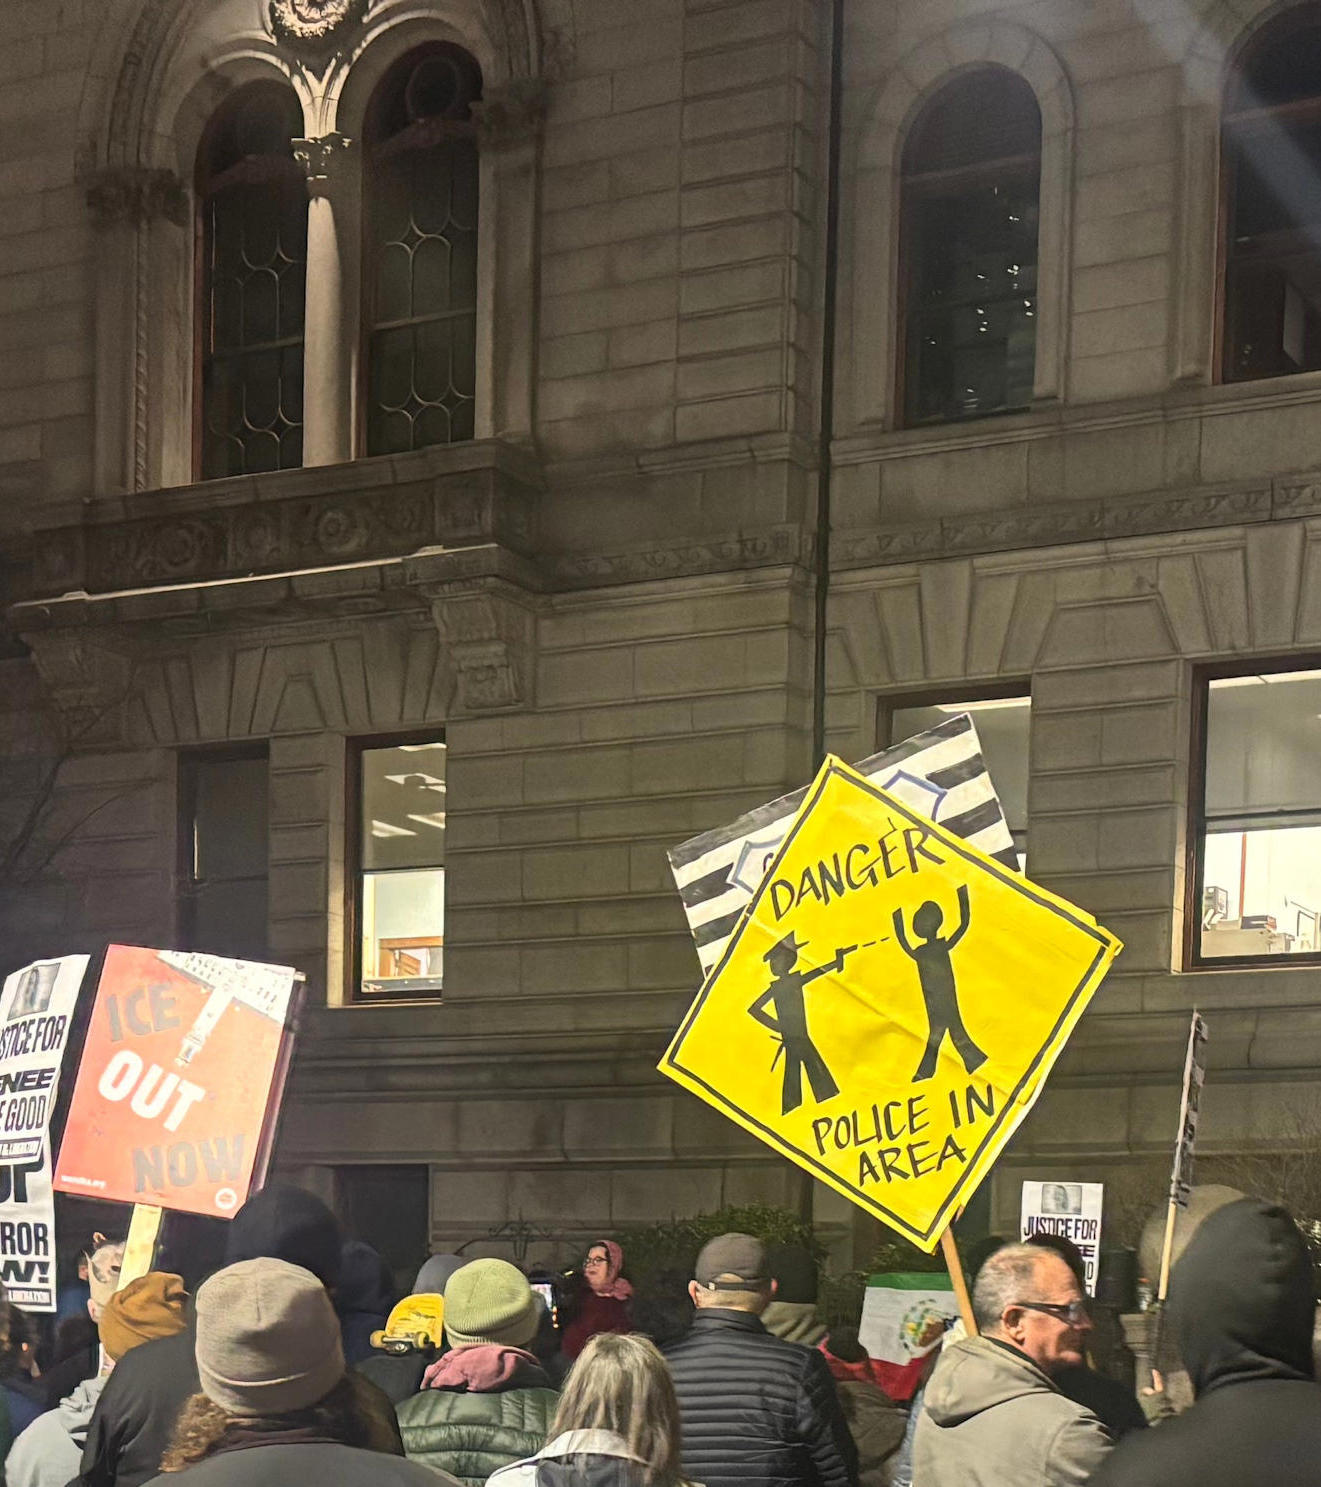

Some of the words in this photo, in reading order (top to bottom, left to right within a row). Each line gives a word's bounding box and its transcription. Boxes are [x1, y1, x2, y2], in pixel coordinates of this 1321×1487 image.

[770, 822, 946, 922] DANGER
[33, 1014, 67, 1052] FOR
[106, 981, 181, 1043] ICE
[4, 1095, 47, 1132] GOOD
[98, 1049, 207, 1132] OUT
[812, 1094, 930, 1157] POLICE
[949, 1083, 995, 1129] IN
[132, 1133, 245, 1193] NOW
[859, 1134, 967, 1187] AREA
[1023, 1216, 1073, 1239] JUSTICE
[1074, 1219, 1098, 1241] FOR
